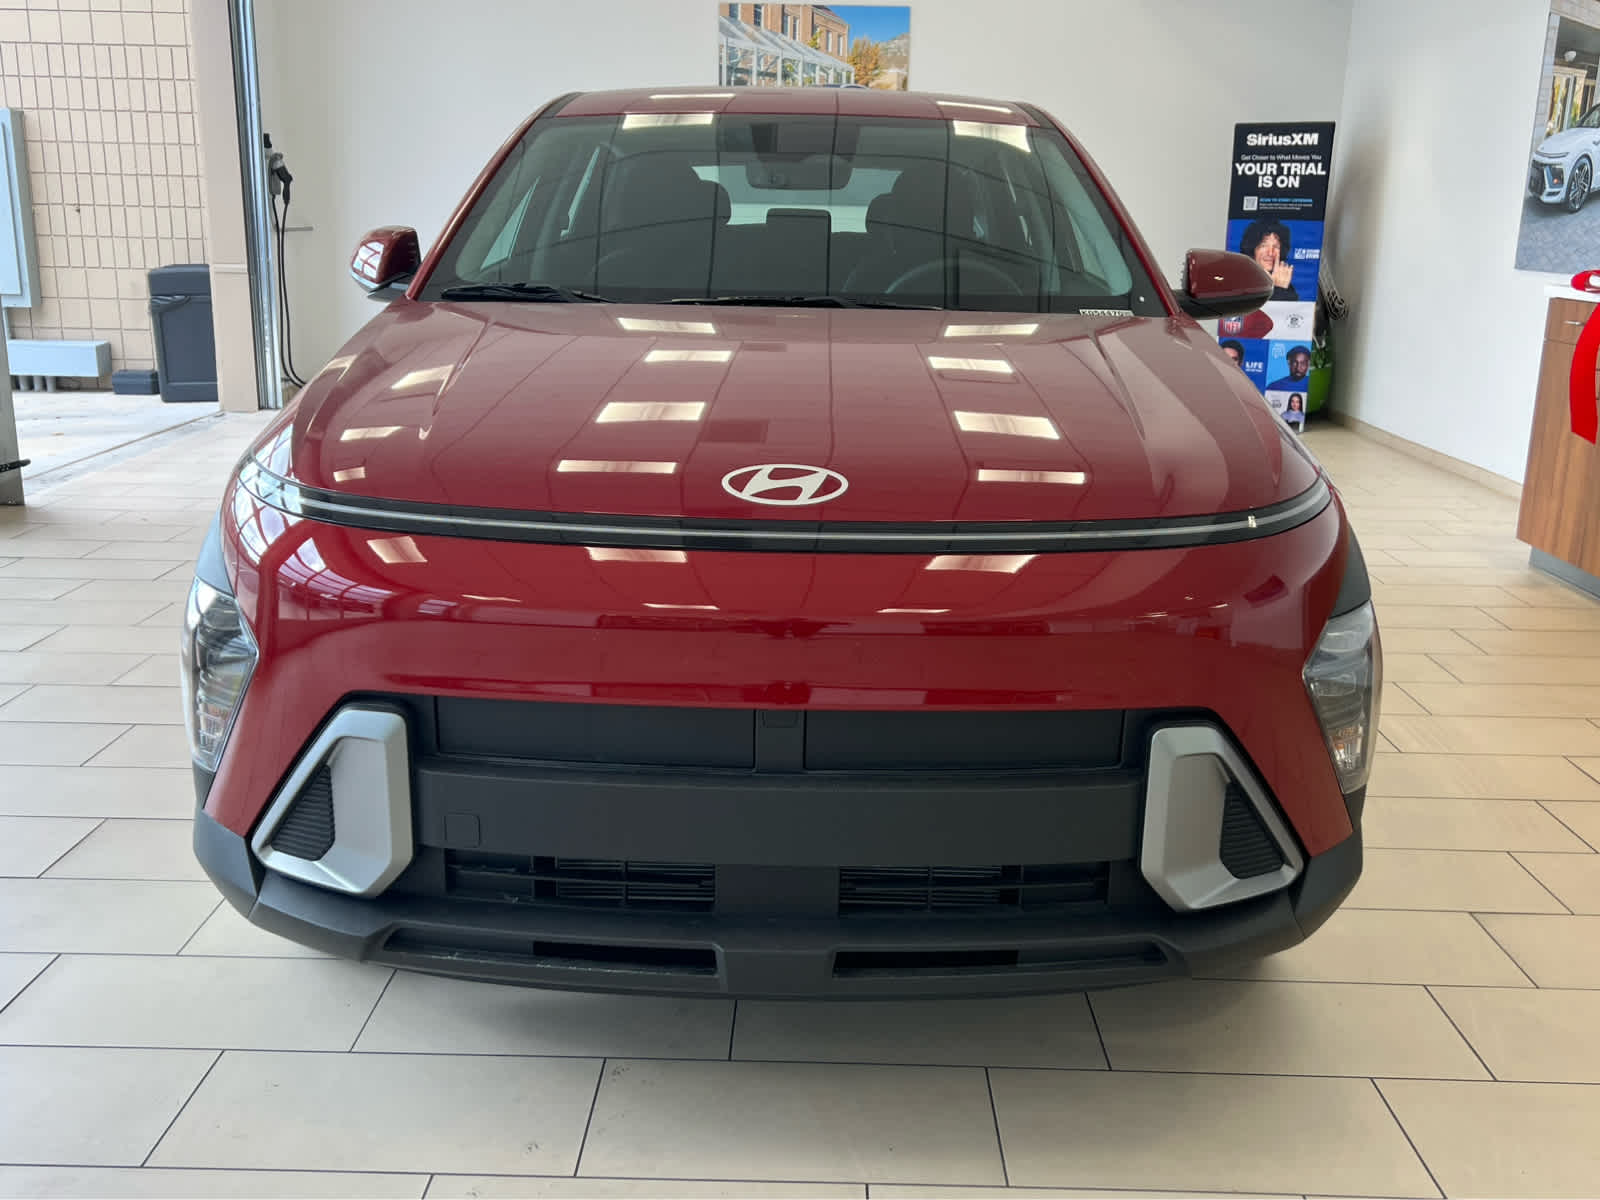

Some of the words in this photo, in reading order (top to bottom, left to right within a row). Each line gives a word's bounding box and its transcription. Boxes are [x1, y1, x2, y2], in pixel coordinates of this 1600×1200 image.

[1246, 133, 1319, 146] SiriusXM
[1235, 162, 1277, 175] YOUR
[1281, 162, 1326, 175] TRIAL
[1258, 175, 1273, 188] IS
[1276, 175, 1300, 188] ON
[1245, 361, 1264, 369] LIFE
